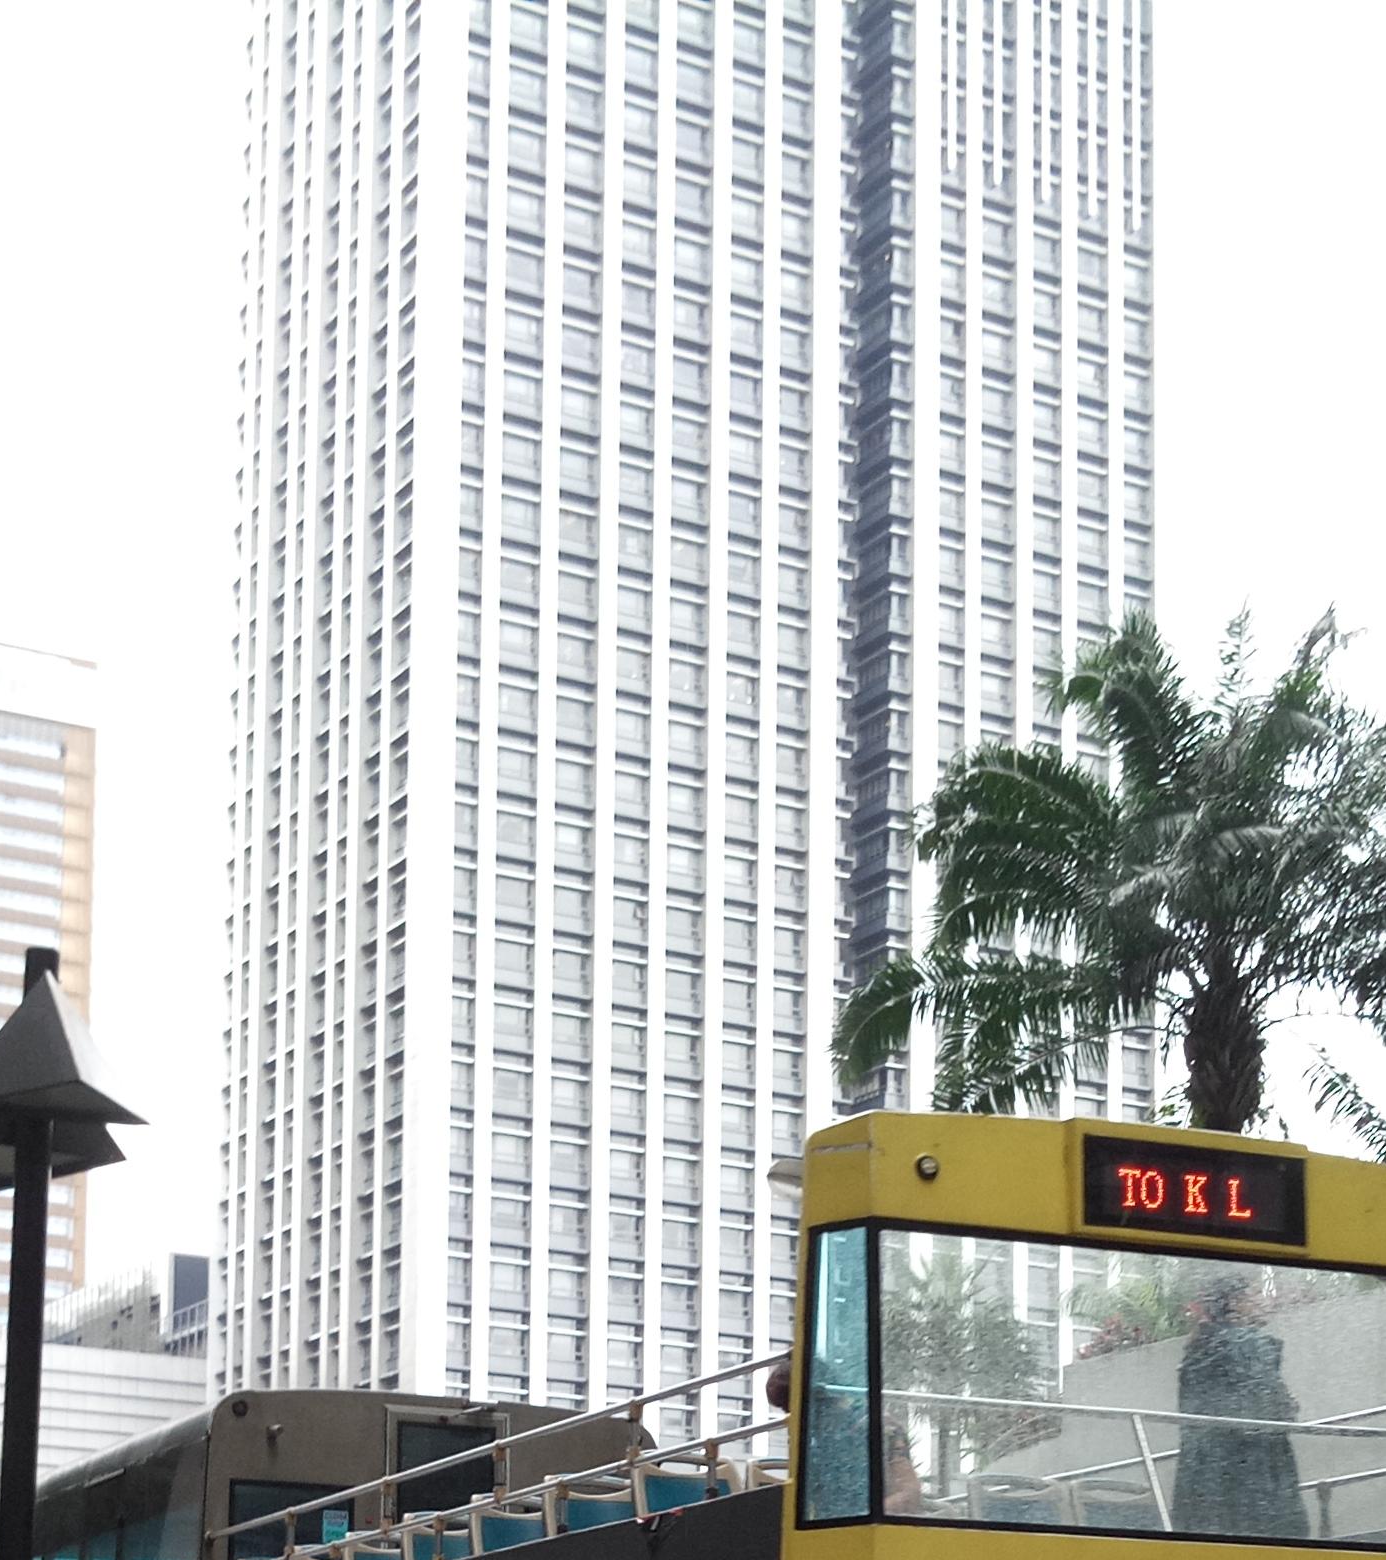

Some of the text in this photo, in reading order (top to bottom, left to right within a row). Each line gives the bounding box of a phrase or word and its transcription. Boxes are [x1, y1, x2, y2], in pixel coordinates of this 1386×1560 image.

[1117, 1167, 1253, 1219] TO K L
